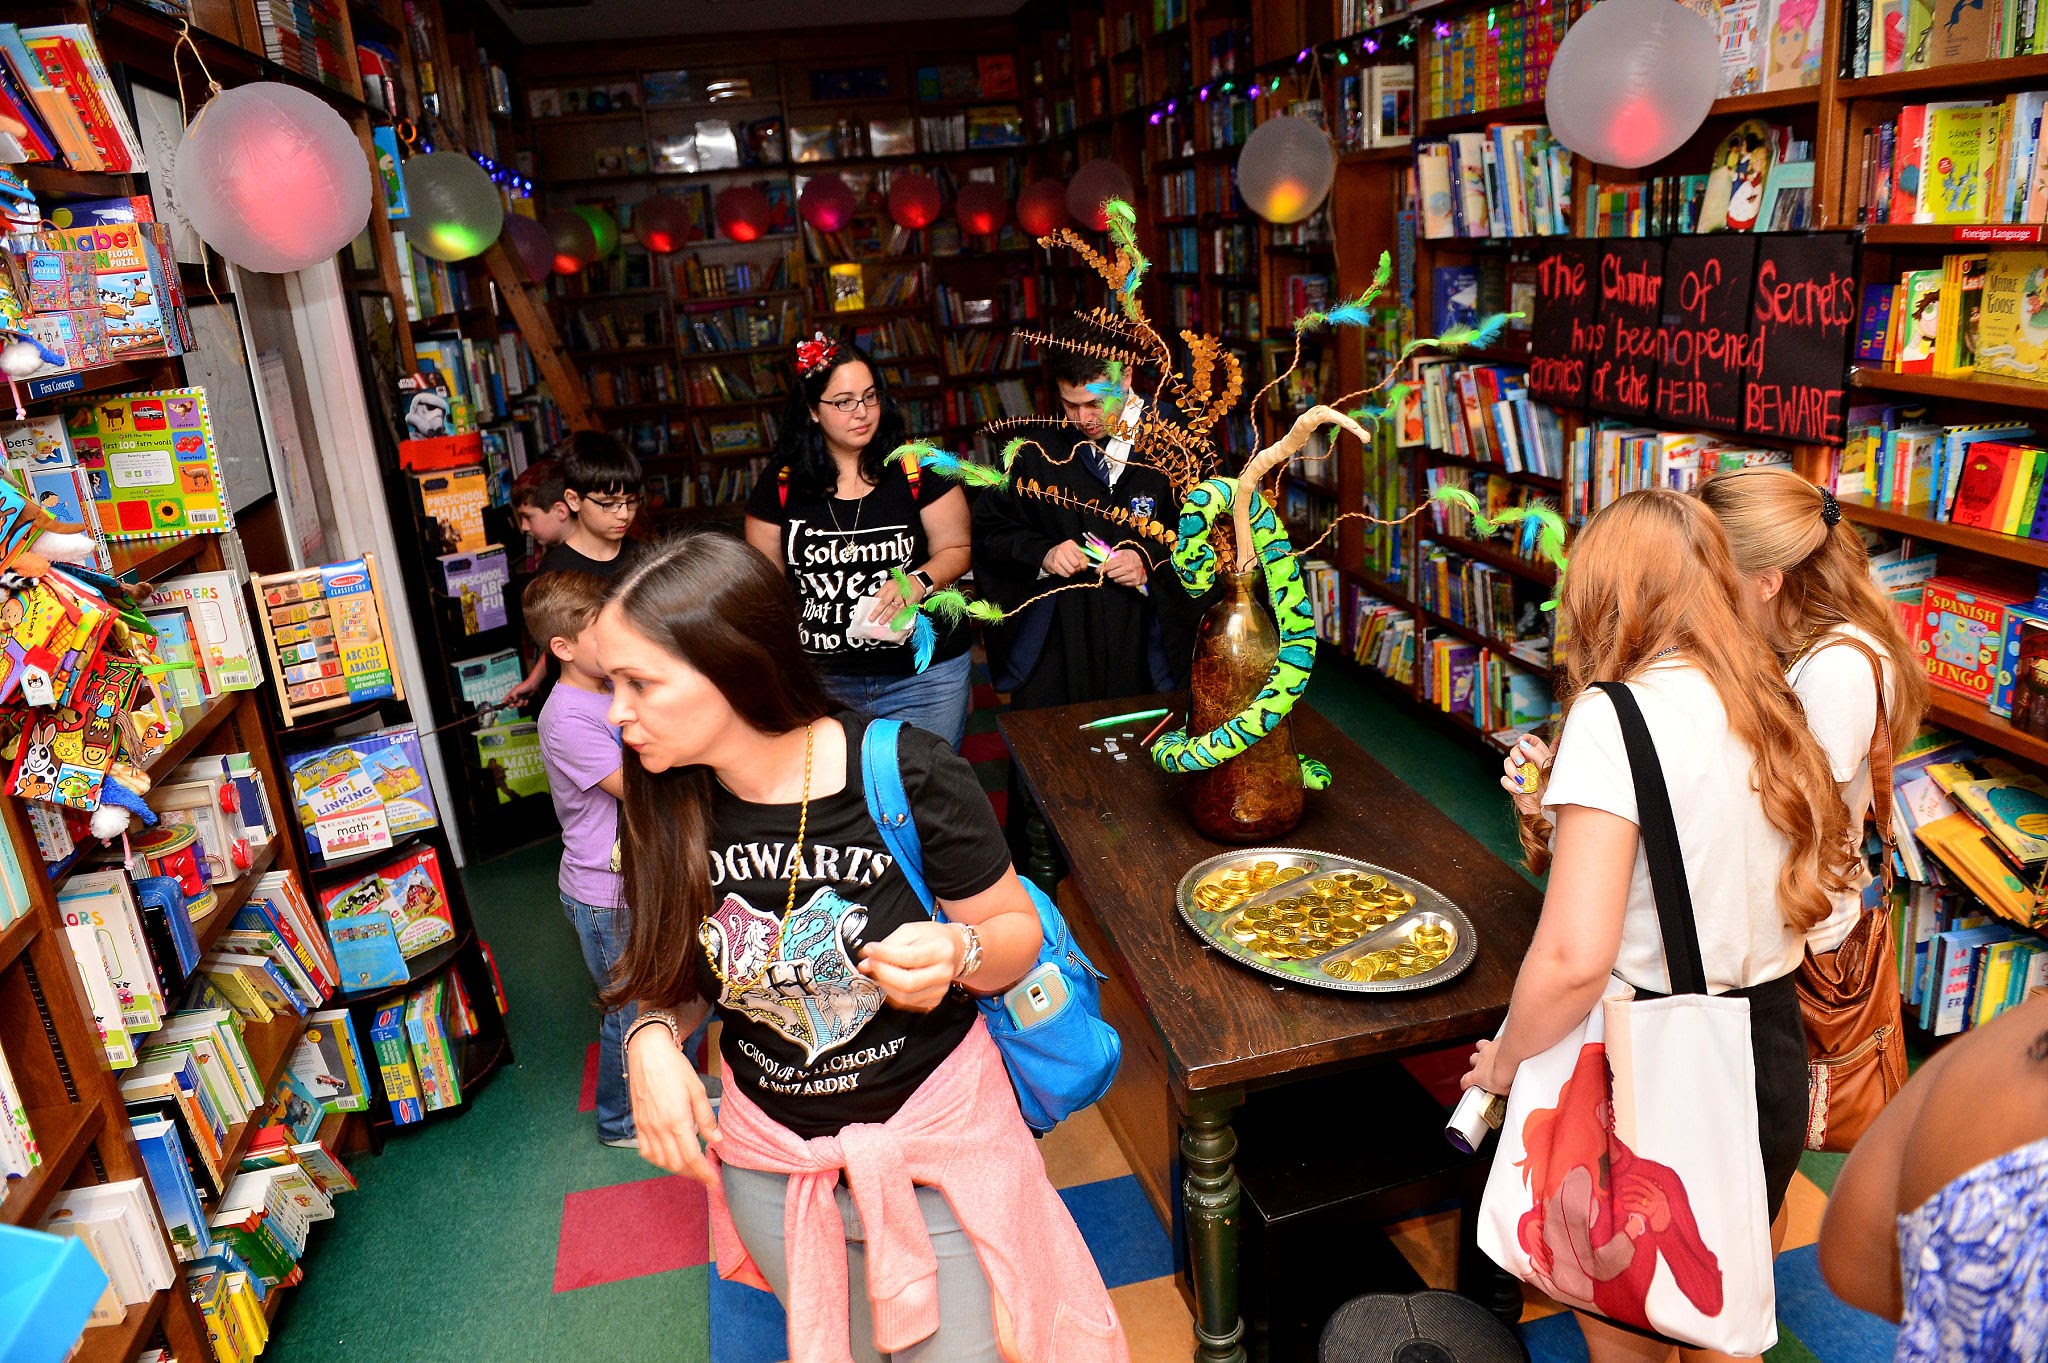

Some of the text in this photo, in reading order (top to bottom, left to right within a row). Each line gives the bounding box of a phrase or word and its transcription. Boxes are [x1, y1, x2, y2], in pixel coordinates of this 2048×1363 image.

[48, 228, 139, 252] phabet
[1961, 229, 2031, 241] Foreign Language
[108, 249, 134, 258] FLOOR
[110, 257, 141, 268] PUZZLE
[33, 259, 44, 268] 20
[1538, 253, 1587, 299] The
[1754, 258, 1855, 328] Secrets
[1986, 293, 2016, 315] GOOSE
[1571, 317, 1606, 352] has
[40, 379, 75, 394] First Concepts
[1529, 355, 1584, 394] enemies
[1615, 365, 1649, 408] the
[1744, 382, 1846, 442] BEWARE
[6, 438, 34, 449] bers
[102, 442, 118, 450] first
[118, 441, 136, 450] 100
[427, 489, 487, 509] PRESCHOOL
[461, 517, 485, 530] COLO
[787, 519, 806, 566] I
[804, 532, 915, 567] solemnly
[448, 567, 505, 590] PRESCHOOL
[794, 559, 912, 600] swea
[150, 587, 219, 606] NUMBERS
[331, 586, 353, 596] CLASSIC
[802, 598, 832, 621] that
[833, 602, 844, 624] I
[1932, 595, 1998, 625] SPANISH
[812, 633, 841, 650] no
[350, 658, 381, 674] ABACUS
[1926, 657, 1988, 692] BINGO
[389, 733, 414, 746] Safari
[504, 751, 543, 769] MATH
[505, 765, 546, 781] SKILLS
[322, 789, 338, 801] 4
[339, 785, 348, 794] in
[337, 822, 369, 837] math
[418, 852, 435, 864] Farm
[709, 842, 893, 887] OGWARTS
[66, 911, 104, 927] ORS
[128, 923, 140, 957] COLORS
[294, 940, 317, 973] TRAINS
[1954, 948, 1968, 960] LA
[738, 1039, 780, 1075] SCHOOL
[383, 1071, 396, 1096] DELUXE
[402, 1075, 412, 1087] SET
[758, 1072, 860, 1096] & WIZARDRY
[0, 1090, 14, 1128] Words
